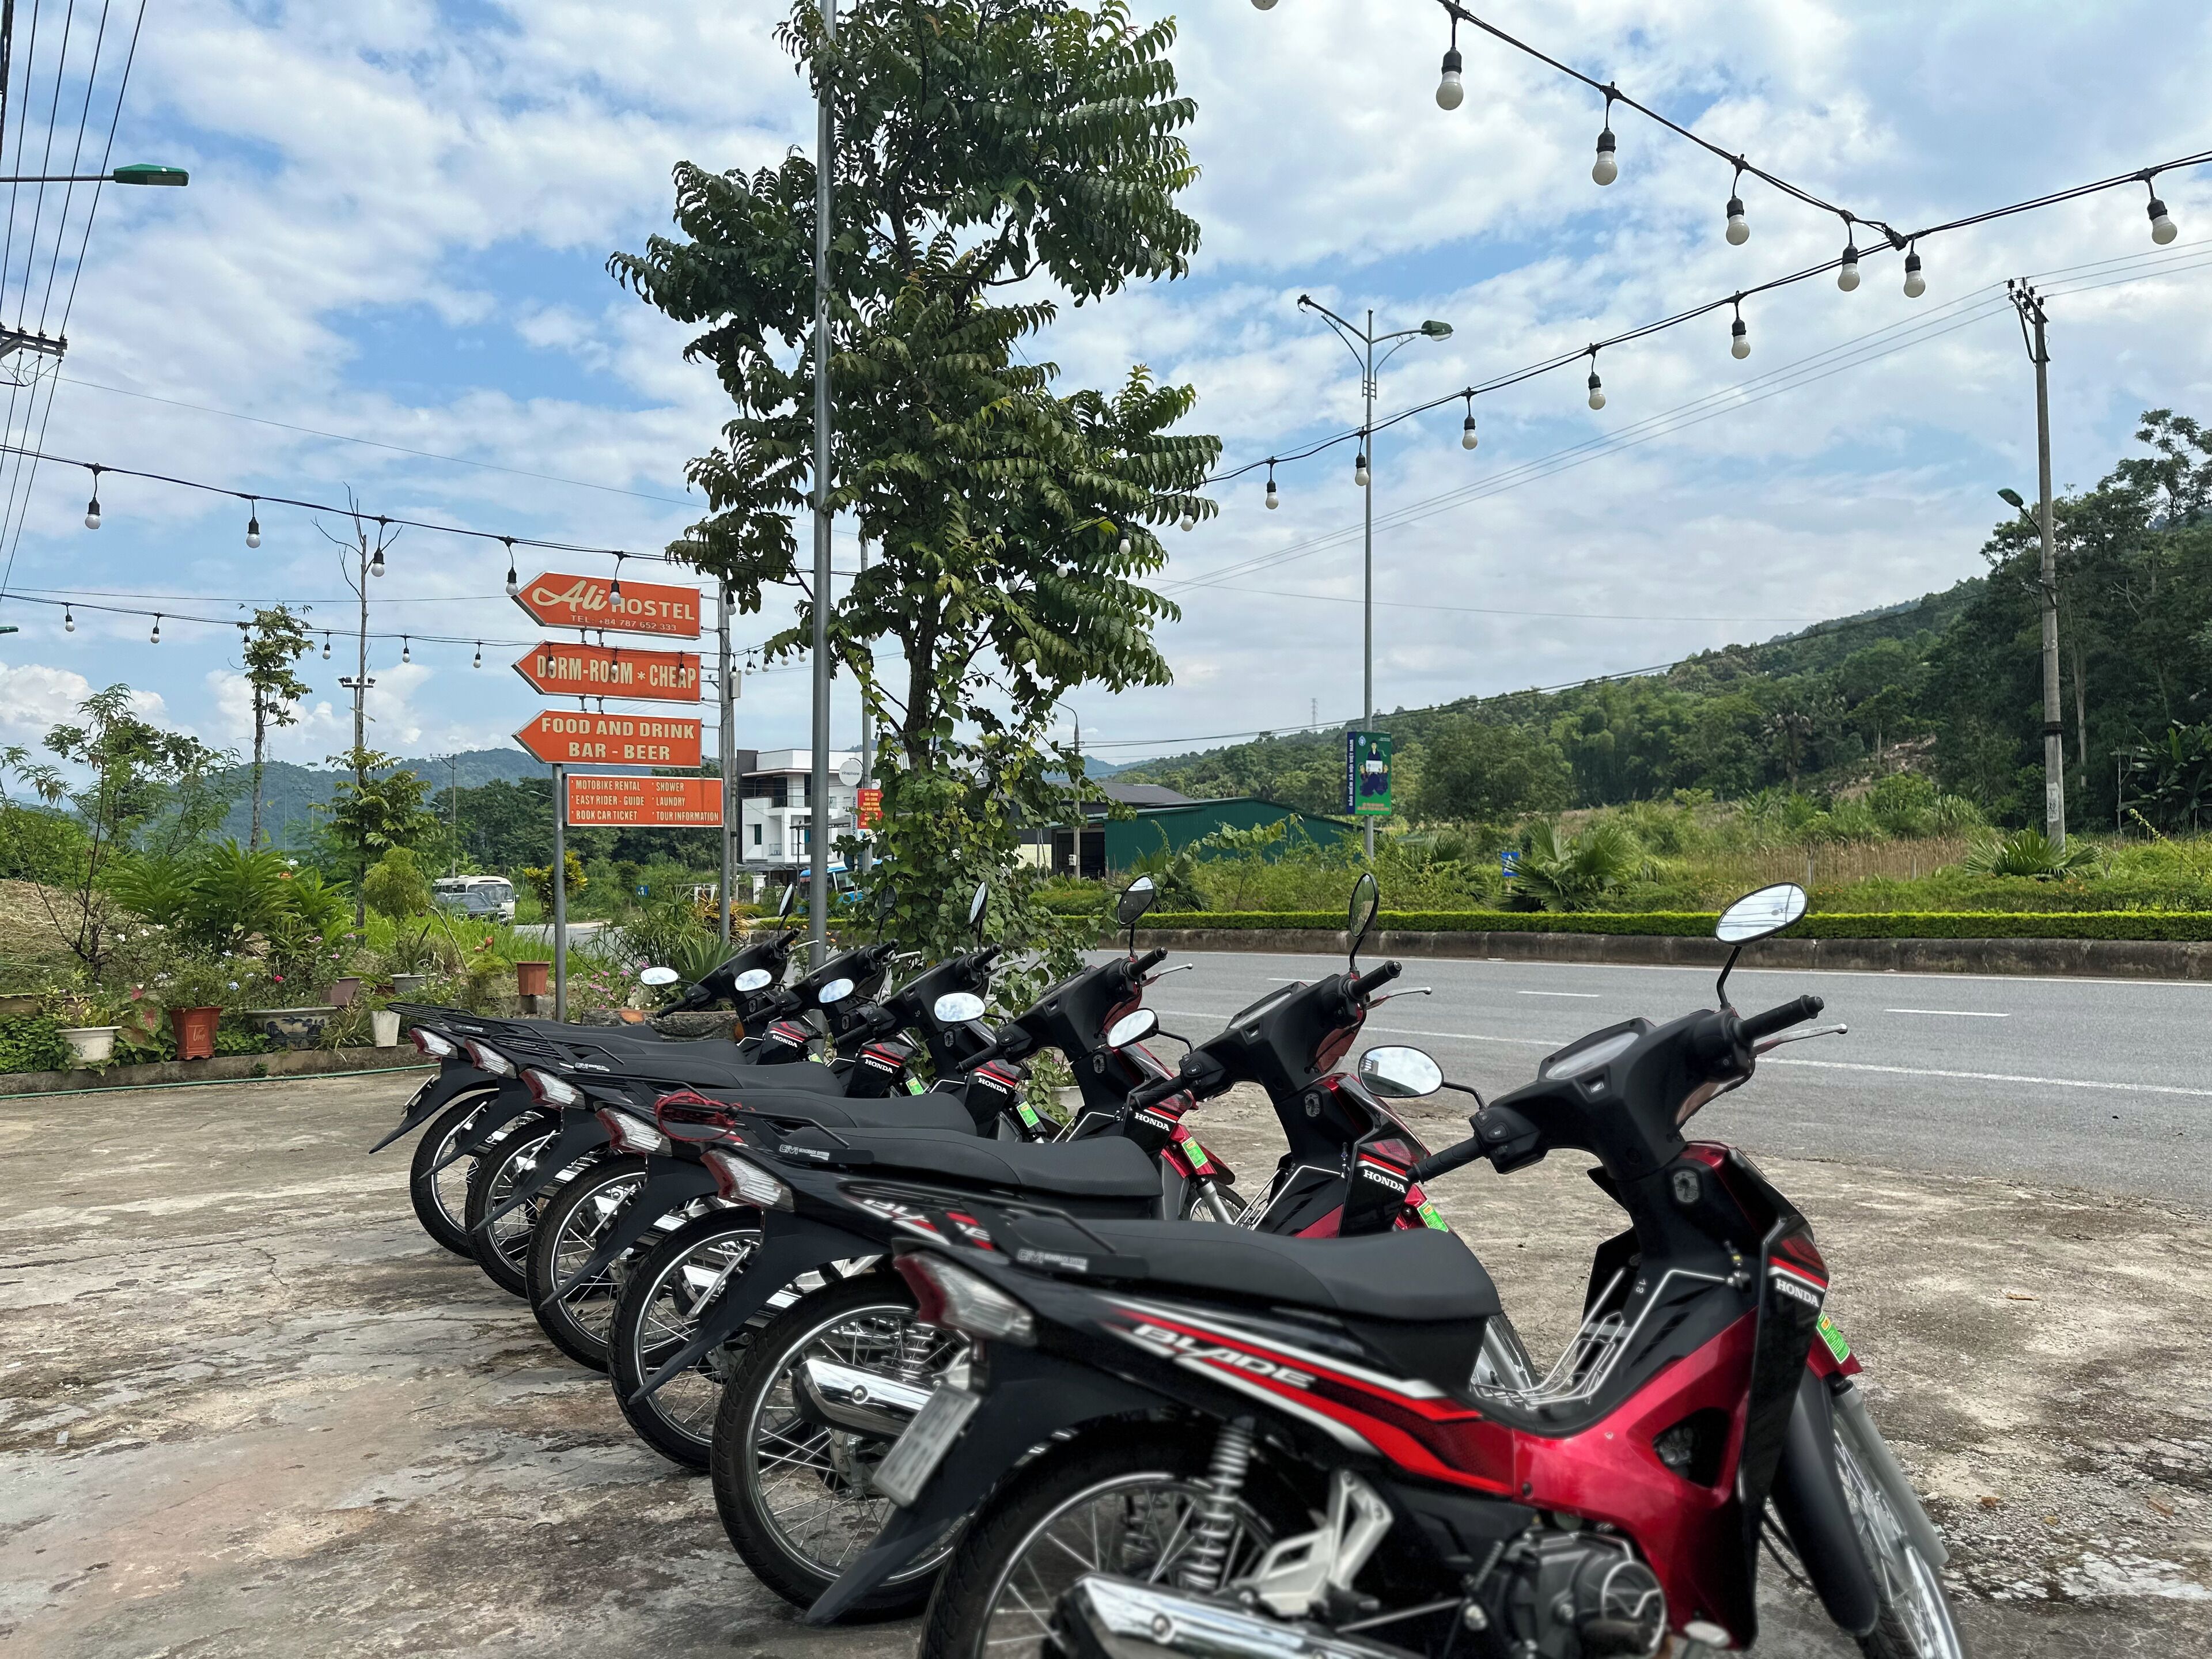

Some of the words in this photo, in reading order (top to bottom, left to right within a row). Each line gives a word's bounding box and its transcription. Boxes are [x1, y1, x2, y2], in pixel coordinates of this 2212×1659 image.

[532, 579, 608, 612] Ali
[611, 597, 695, 620] HOSTEL
[571, 615, 594, 624] TEL:
[620, 619, 636, 627] 787
[660, 623, 676, 631] 333
[541, 717, 590, 734] FOOD
[596, 720, 634, 736] AND
[639, 722, 695, 739] DRINK
[569, 741, 606, 757] BAR
[624, 744, 670, 760] BEER
[576, 779, 613, 791] MOTOBIKE
[615, 781, 641, 791] RENTAL
[656, 782, 684, 792] SHOWER
[576, 795, 594, 805] EASY
[596, 796, 618, 805] RIDER
[624, 796, 645, 806] GUIDE
[656, 797, 685, 806] LAUNDRY
[576, 810, 596, 820] BOOK
[597, 810, 612, 820] CAR
[613, 810, 638, 821] TICKET
[656, 811, 673, 821] TOUR
[675, 811, 719, 821] INFORMATION
[772, 1034, 798, 1048] HONDA
[865, 1059, 893, 1074] HONDA
[978, 1077, 1007, 1094] HONDA
[1134, 1112, 1170, 1132] HONDA
[1363, 1169, 1406, 1194] HONDA
[1775, 1278, 1819, 1308] HONDA
[1132, 1323, 1317, 1389] BLADE
